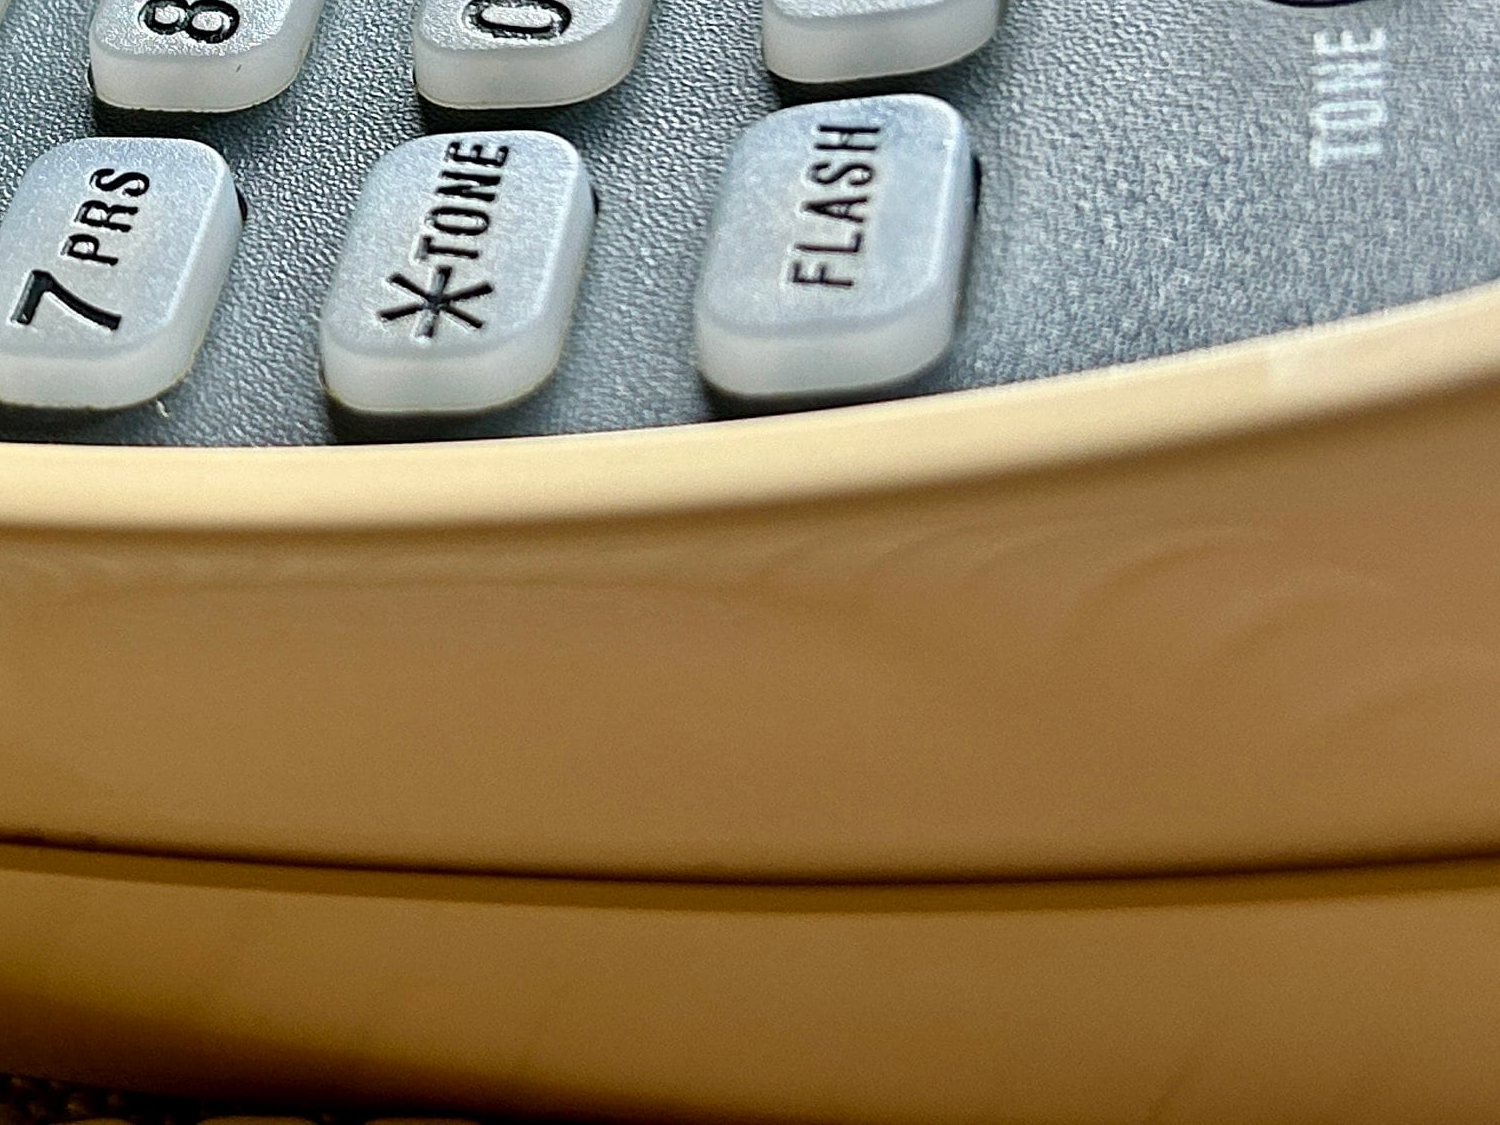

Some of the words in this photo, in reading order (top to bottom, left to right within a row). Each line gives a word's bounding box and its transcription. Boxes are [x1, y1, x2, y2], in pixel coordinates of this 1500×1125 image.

[1308, 27, 1388, 167] TONE
[60, 166, 151, 266] PRS
[418, 139, 510, 262] TONE
[787, 123, 882, 289] FLASH
[10, 269, 123, 333] 7
